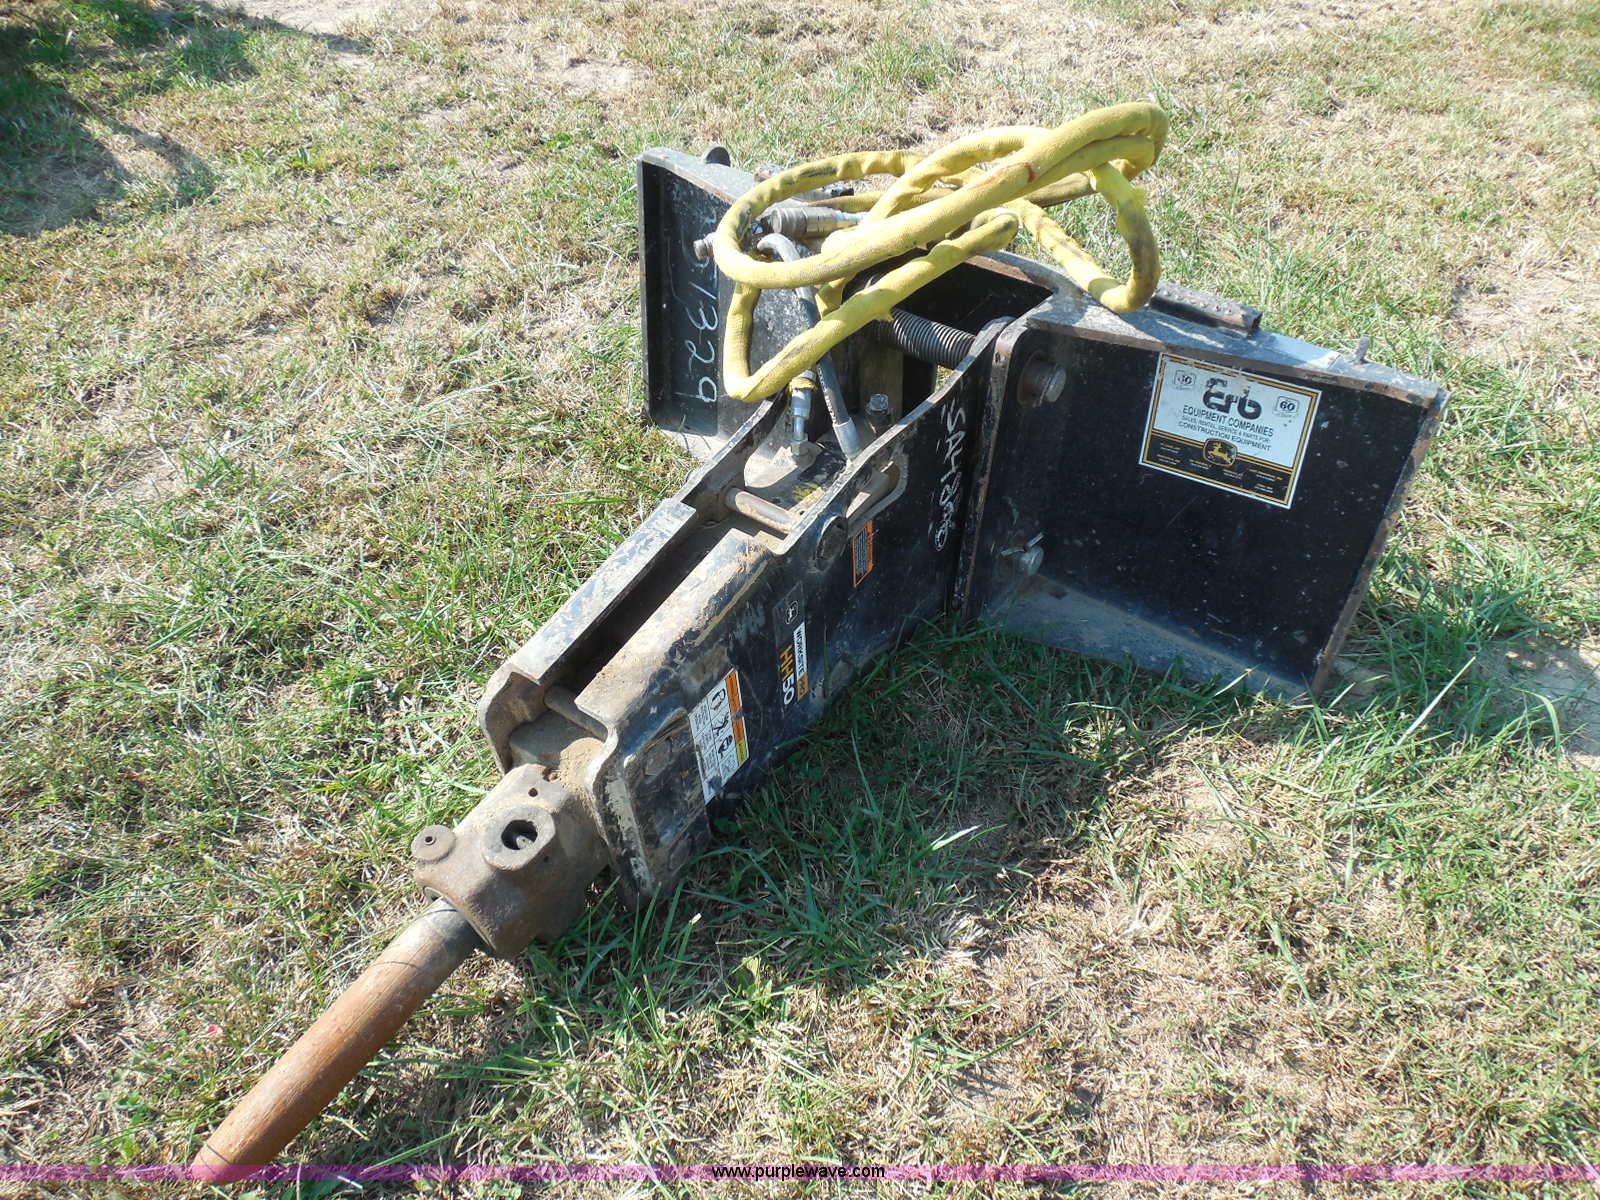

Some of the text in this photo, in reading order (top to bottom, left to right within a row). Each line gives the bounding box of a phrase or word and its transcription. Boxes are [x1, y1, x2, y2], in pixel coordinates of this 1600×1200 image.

[1183, 404, 1273, 437] EQUIPMENT COMPANIES
[1280, 401, 1295, 412] 60
[1178, 421, 1272, 451] CONSTRUCTION EQUIPMENT
[779, 644, 794, 705] HH50
